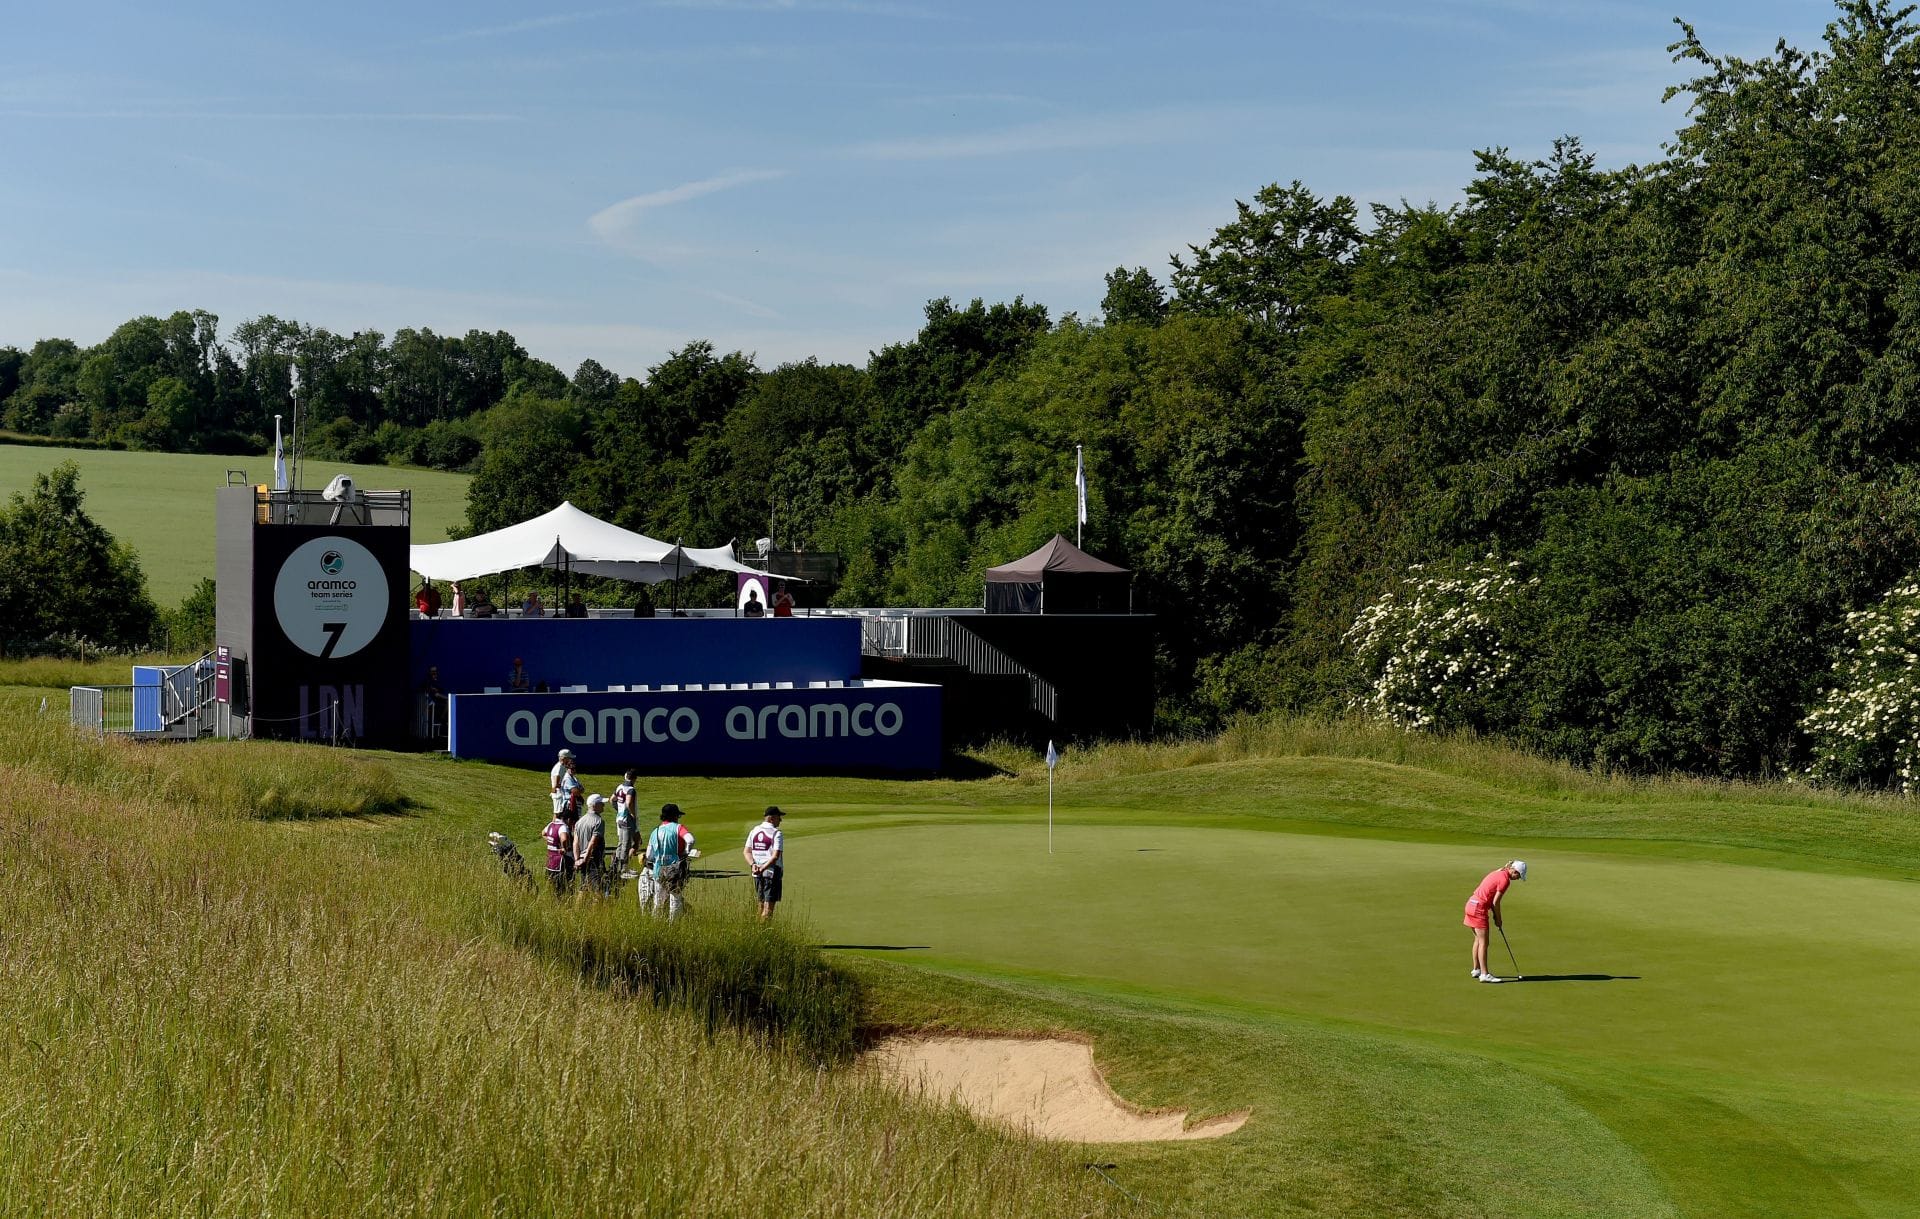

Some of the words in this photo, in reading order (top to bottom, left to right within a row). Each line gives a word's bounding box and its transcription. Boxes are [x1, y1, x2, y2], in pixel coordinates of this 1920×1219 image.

[307, 580, 357, 590] aramco
[332, 590, 353, 598] series
[320, 623, 348, 659] 7
[299, 684, 364, 737] LDN
[505, 706, 700, 746] aramco
[725, 702, 904, 740] aramco
